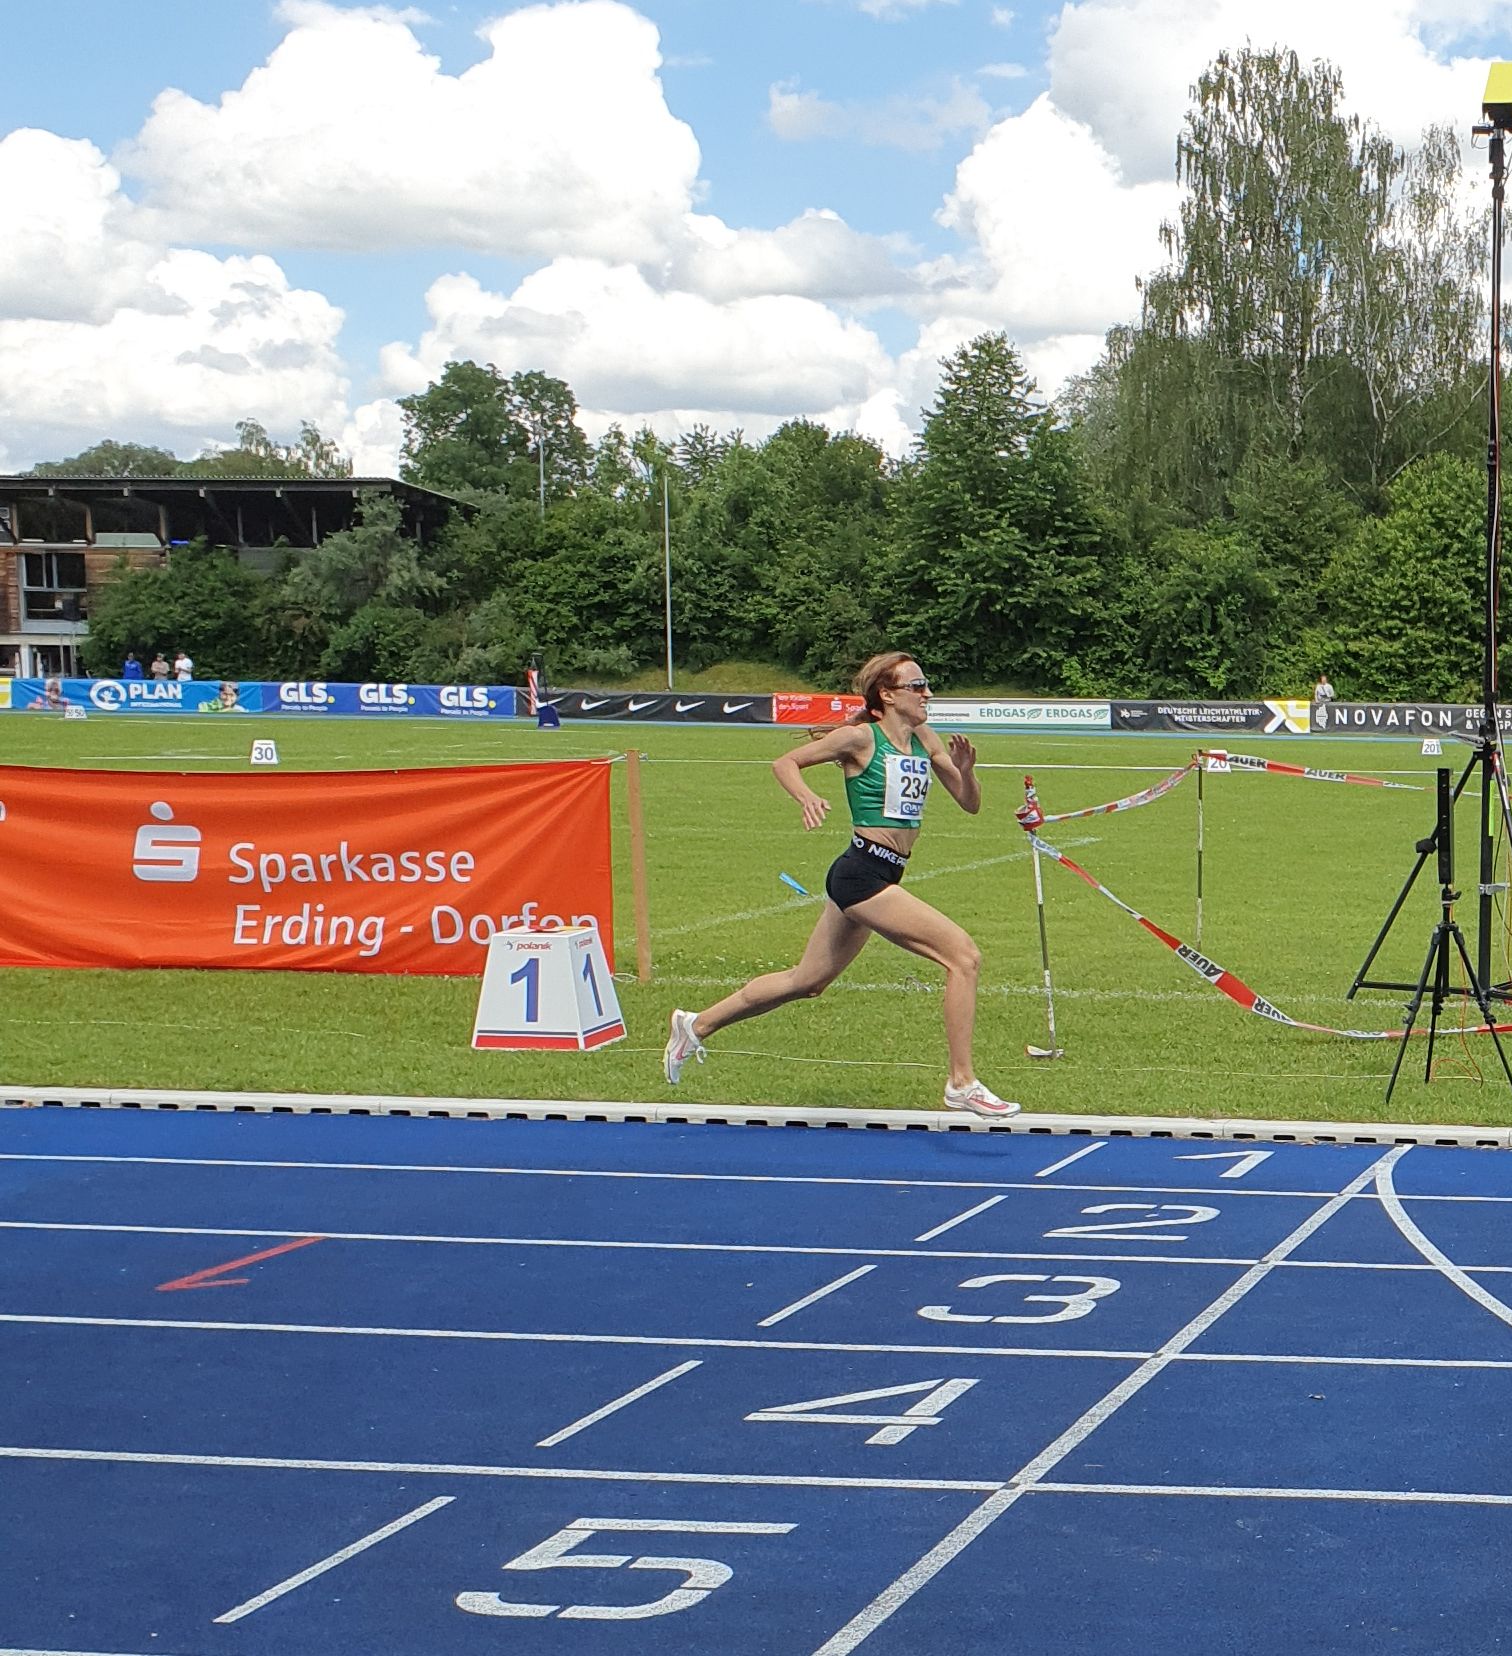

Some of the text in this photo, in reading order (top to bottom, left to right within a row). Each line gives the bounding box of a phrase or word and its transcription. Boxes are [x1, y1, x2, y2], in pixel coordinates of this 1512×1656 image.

[129, 682, 183, 700] PLAN
[979, 708, 1026, 718] ERDGAS
[1046, 709, 1092, 719] ERDGAS
[1157, 707, 1199, 715] DEUTSCHE
[1174, 714, 1246, 723] MEISTERSCHAFTEN
[1335, 708, 1452, 727] NOVAFON
[1465, 719, 1474, 729] &
[253, 746, 275, 761] 30
[900, 758, 928, 775] GLS
[1305, 768, 1346, 781] AUER
[868, 843, 898, 864] NIKE
[228, 840, 475, 893] Sparkasse
[233, 904, 386, 957] Erding
[510, 957, 539, 1023] 1
[582, 952, 604, 1017] 1
[1173, 1150, 1275, 1178] 1
[1043, 1203, 1222, 1241] 2
[916, 1274, 1122, 1325] 3
[742, 1377, 982, 1446] 4
[454, 1517, 800, 1620] 5
